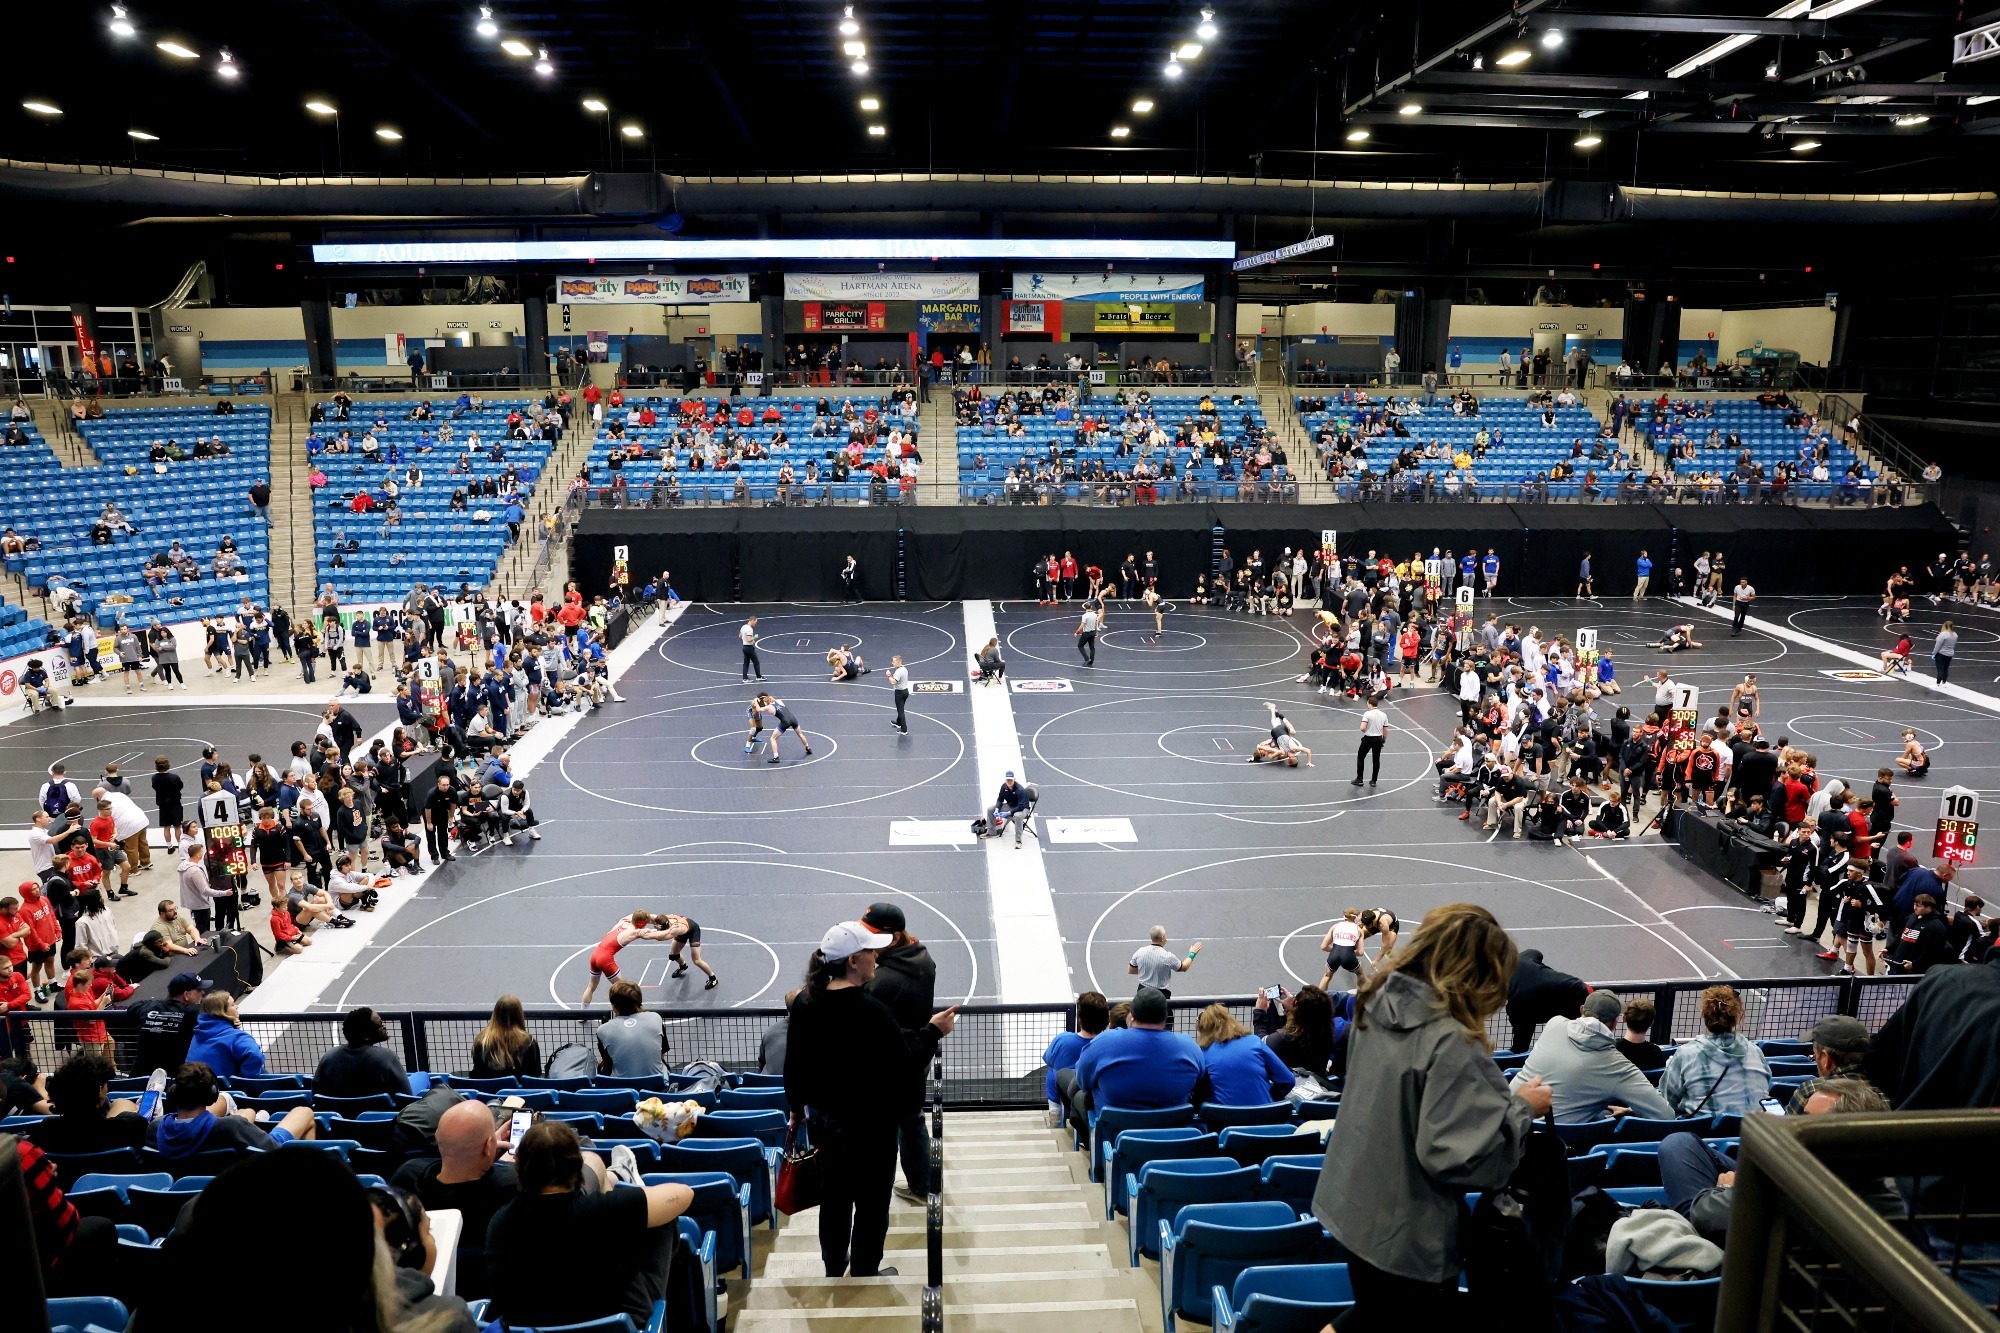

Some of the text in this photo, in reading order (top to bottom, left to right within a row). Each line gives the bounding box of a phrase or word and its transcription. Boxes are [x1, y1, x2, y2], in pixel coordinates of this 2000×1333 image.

[562, 278, 620, 296] PARK city
[626, 277, 683, 295] PARK city
[689, 276, 745, 294] PARK city
[788, 286, 833, 295] VenuWorks
[840, 282, 923, 290] HARTMAN ARENA
[931, 287, 976, 295] VenuWorks
[1171, 293, 1202, 301] ENERGY
[563, 305, 571, 330] ATM
[944, 312, 963, 321] BAR
[1012, 313, 1042, 321] CANTINA
[1324, 532, 1329, 543] 5
[618, 548, 624, 560] 2
[1461, 590, 1469, 603] 6
[463, 606, 470, 620] 1
[1579, 632, 1586, 648] 9
[53, 669, 68, 677] TACO
[423, 661, 432, 678] 3
[1682, 689, 1691, 708] 7
[1671, 711, 1697, 720] 3009
[1673, 740, 1694, 750] 2:04
[213, 800, 229, 823] 4
[1945, 794, 1974, 819] 10
[210, 825, 240, 839] 1008
[235, 836, 243, 848] 3
[1945, 832, 1975, 847] 0 0
[1943, 846, 1974, 861] 2:48
